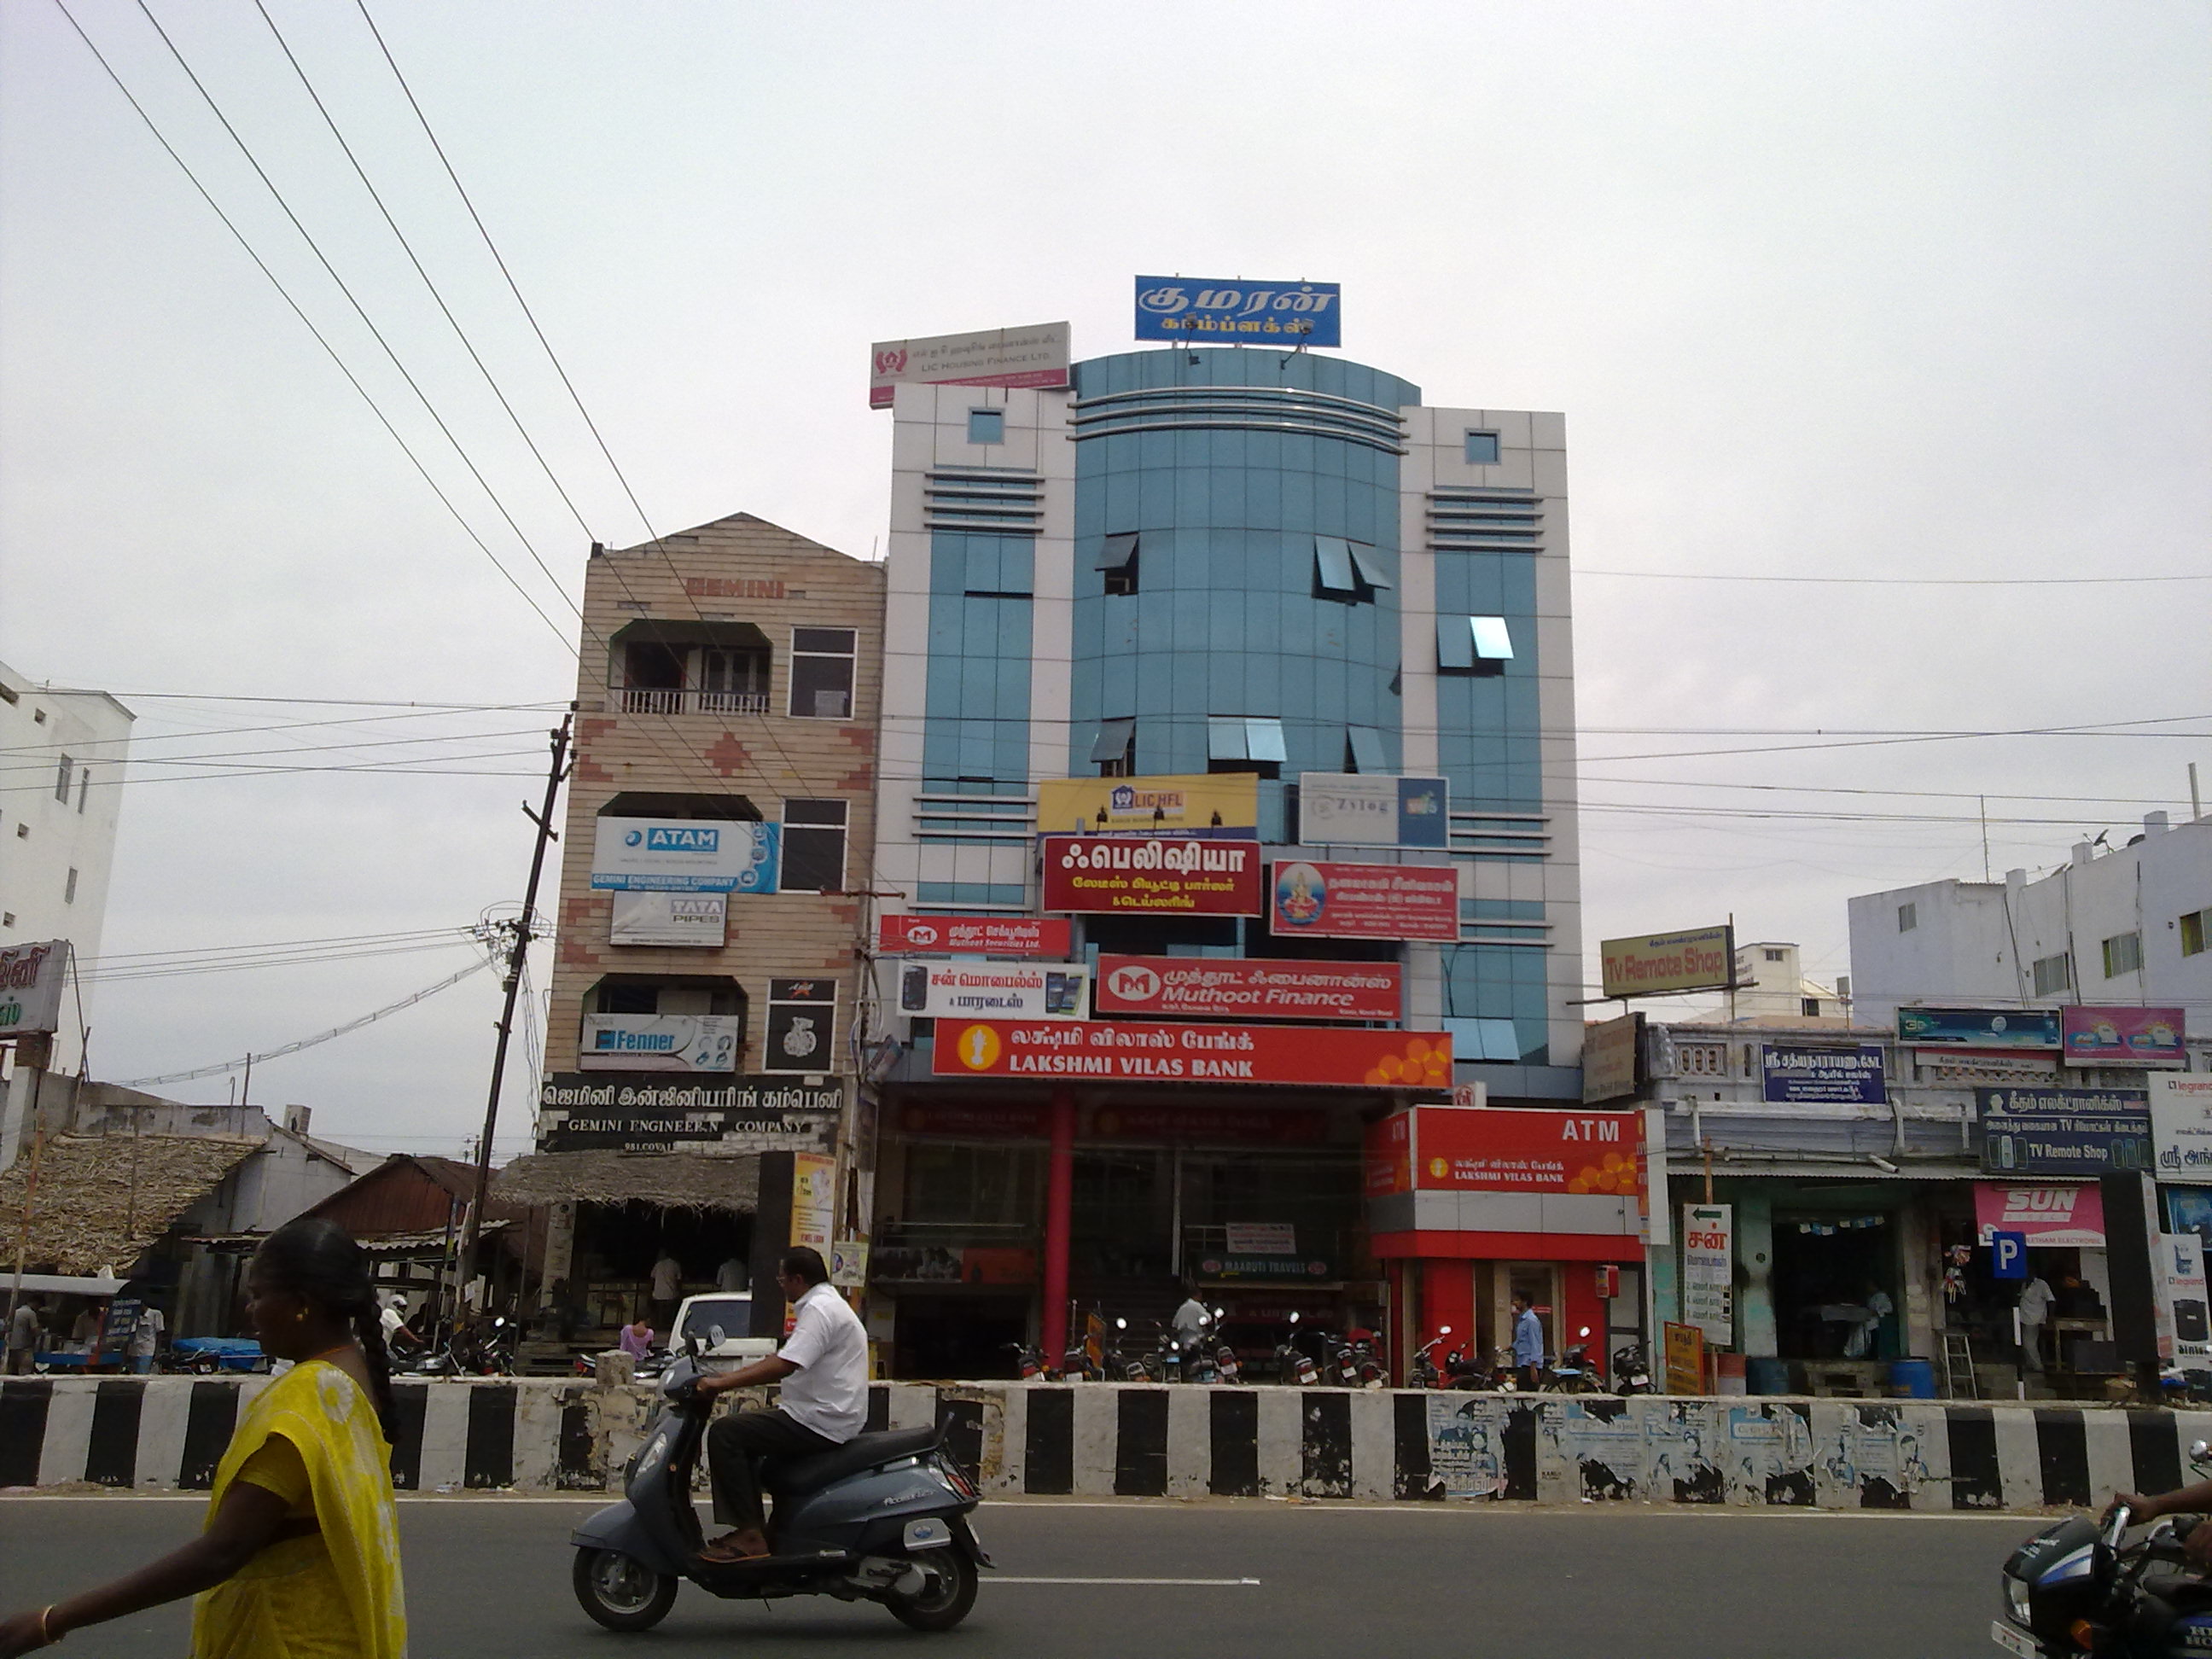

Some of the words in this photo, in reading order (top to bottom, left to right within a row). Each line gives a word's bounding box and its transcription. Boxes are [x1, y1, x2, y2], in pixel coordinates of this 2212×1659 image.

[1138, 286, 1338, 317] குமரன்
[687, 578, 784, 598] GEMINI
[1136, 794, 1155, 807] LIC
[1158, 793, 1183, 806] HFL
[652, 830, 714, 846] ATAM
[672, 900, 723, 914] TATA
[673, 915, 719, 923] PIPES
[1625, 953, 1682, 981] Remote
[1685, 946, 1723, 979] Shop
[931, 969, 957, 987] சன்
[959, 970, 1043, 988] மொபைல்ஸ்
[1161, 987, 1261, 1004] Muthoot
[1265, 989, 1355, 1007] Finance
[617, 1030, 675, 1051] Fenner
[1090, 1027, 1176, 1051] விலாஸ்
[1181, 1030, 1254, 1051] பேங்க்
[1010, 1054, 1112, 1074] LAKSHMI
[1120, 1057, 1184, 1076] VILAS
[1190, 1058, 1254, 1078] BANK
[543, 1085, 614, 1107] ஜெமினி
[762, 1086, 843, 1109] கம்பெனி
[568, 1119, 622, 1132] GEMINI
[736, 1121, 806, 1133] COMPANY
[1562, 1120, 1619, 1142] ATM
[2060, 1119, 2073, 1132] TV
[2029, 1144, 2044, 1158] TV
[2046, 1144, 2082, 1158] Remote
[2083, 1144, 2108, 1161] Shop
[1454, 1171, 1501, 1181] LAKSHMI
[1504, 1172, 1533, 1182] VILAS
[1535, 1173, 1564, 1183] BANK
[2005, 1189, 2079, 1211] SUN
[1688, 1221, 1727, 1250] சன்
[2000, 1239, 2018, 1270] P
